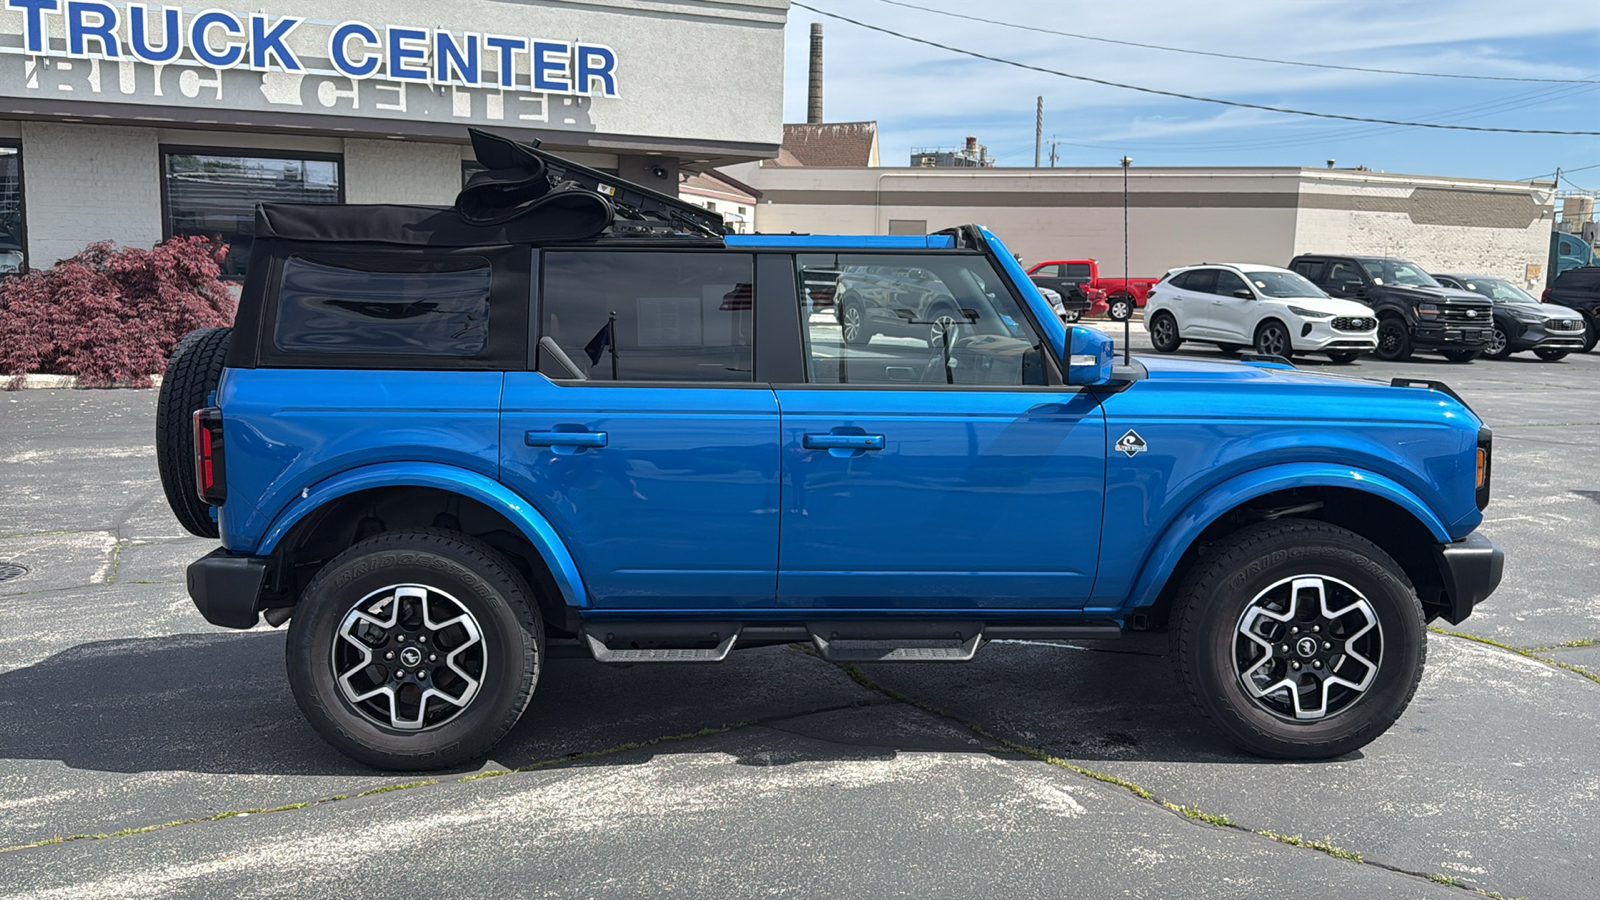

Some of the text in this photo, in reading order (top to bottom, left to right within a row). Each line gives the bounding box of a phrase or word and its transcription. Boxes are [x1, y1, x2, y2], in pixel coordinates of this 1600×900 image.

[5, 0, 622, 99] TRUCK CENTER
[334, 551, 503, 610] BRIDGESTONE
